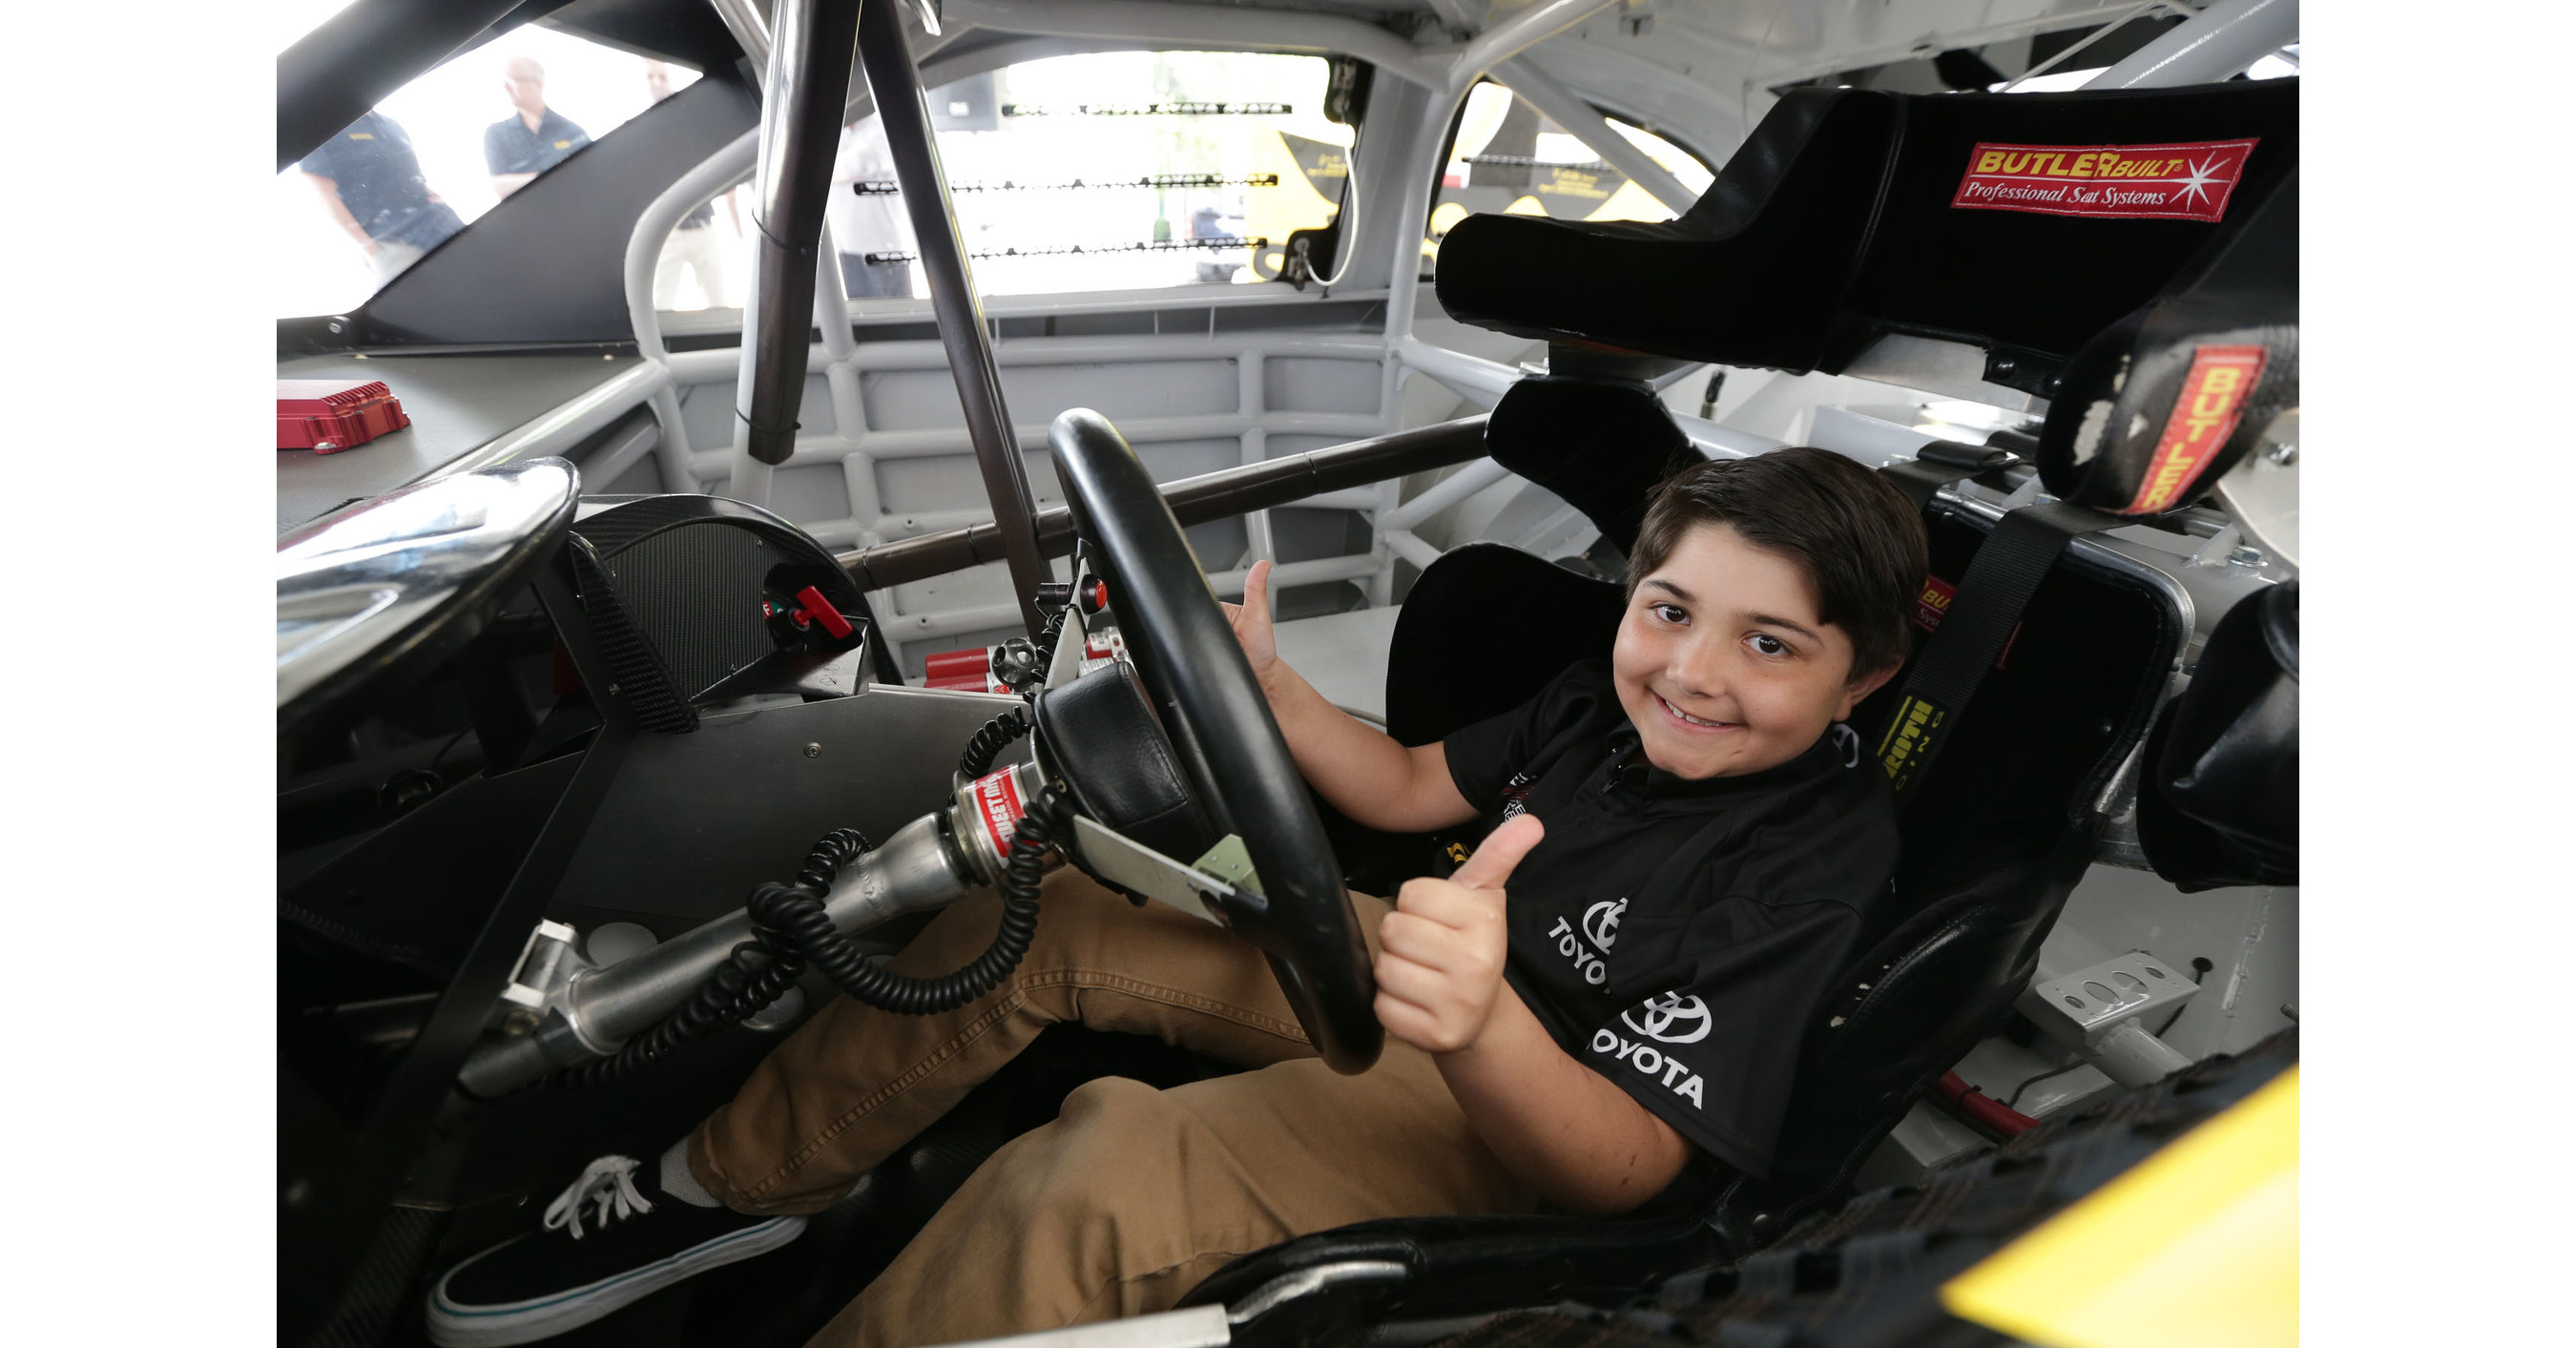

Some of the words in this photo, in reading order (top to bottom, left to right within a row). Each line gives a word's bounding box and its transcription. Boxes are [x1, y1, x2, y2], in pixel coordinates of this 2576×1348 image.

[1964, 181, 2069, 204] Professional
[2101, 188, 2167, 208] Systems
[2142, 367, 2241, 510] BUTLER
[1883, 699, 1934, 779] ROTH
[1548, 915, 1610, 994] TOYO
[1588, 1027, 1704, 1110] OYOTA
